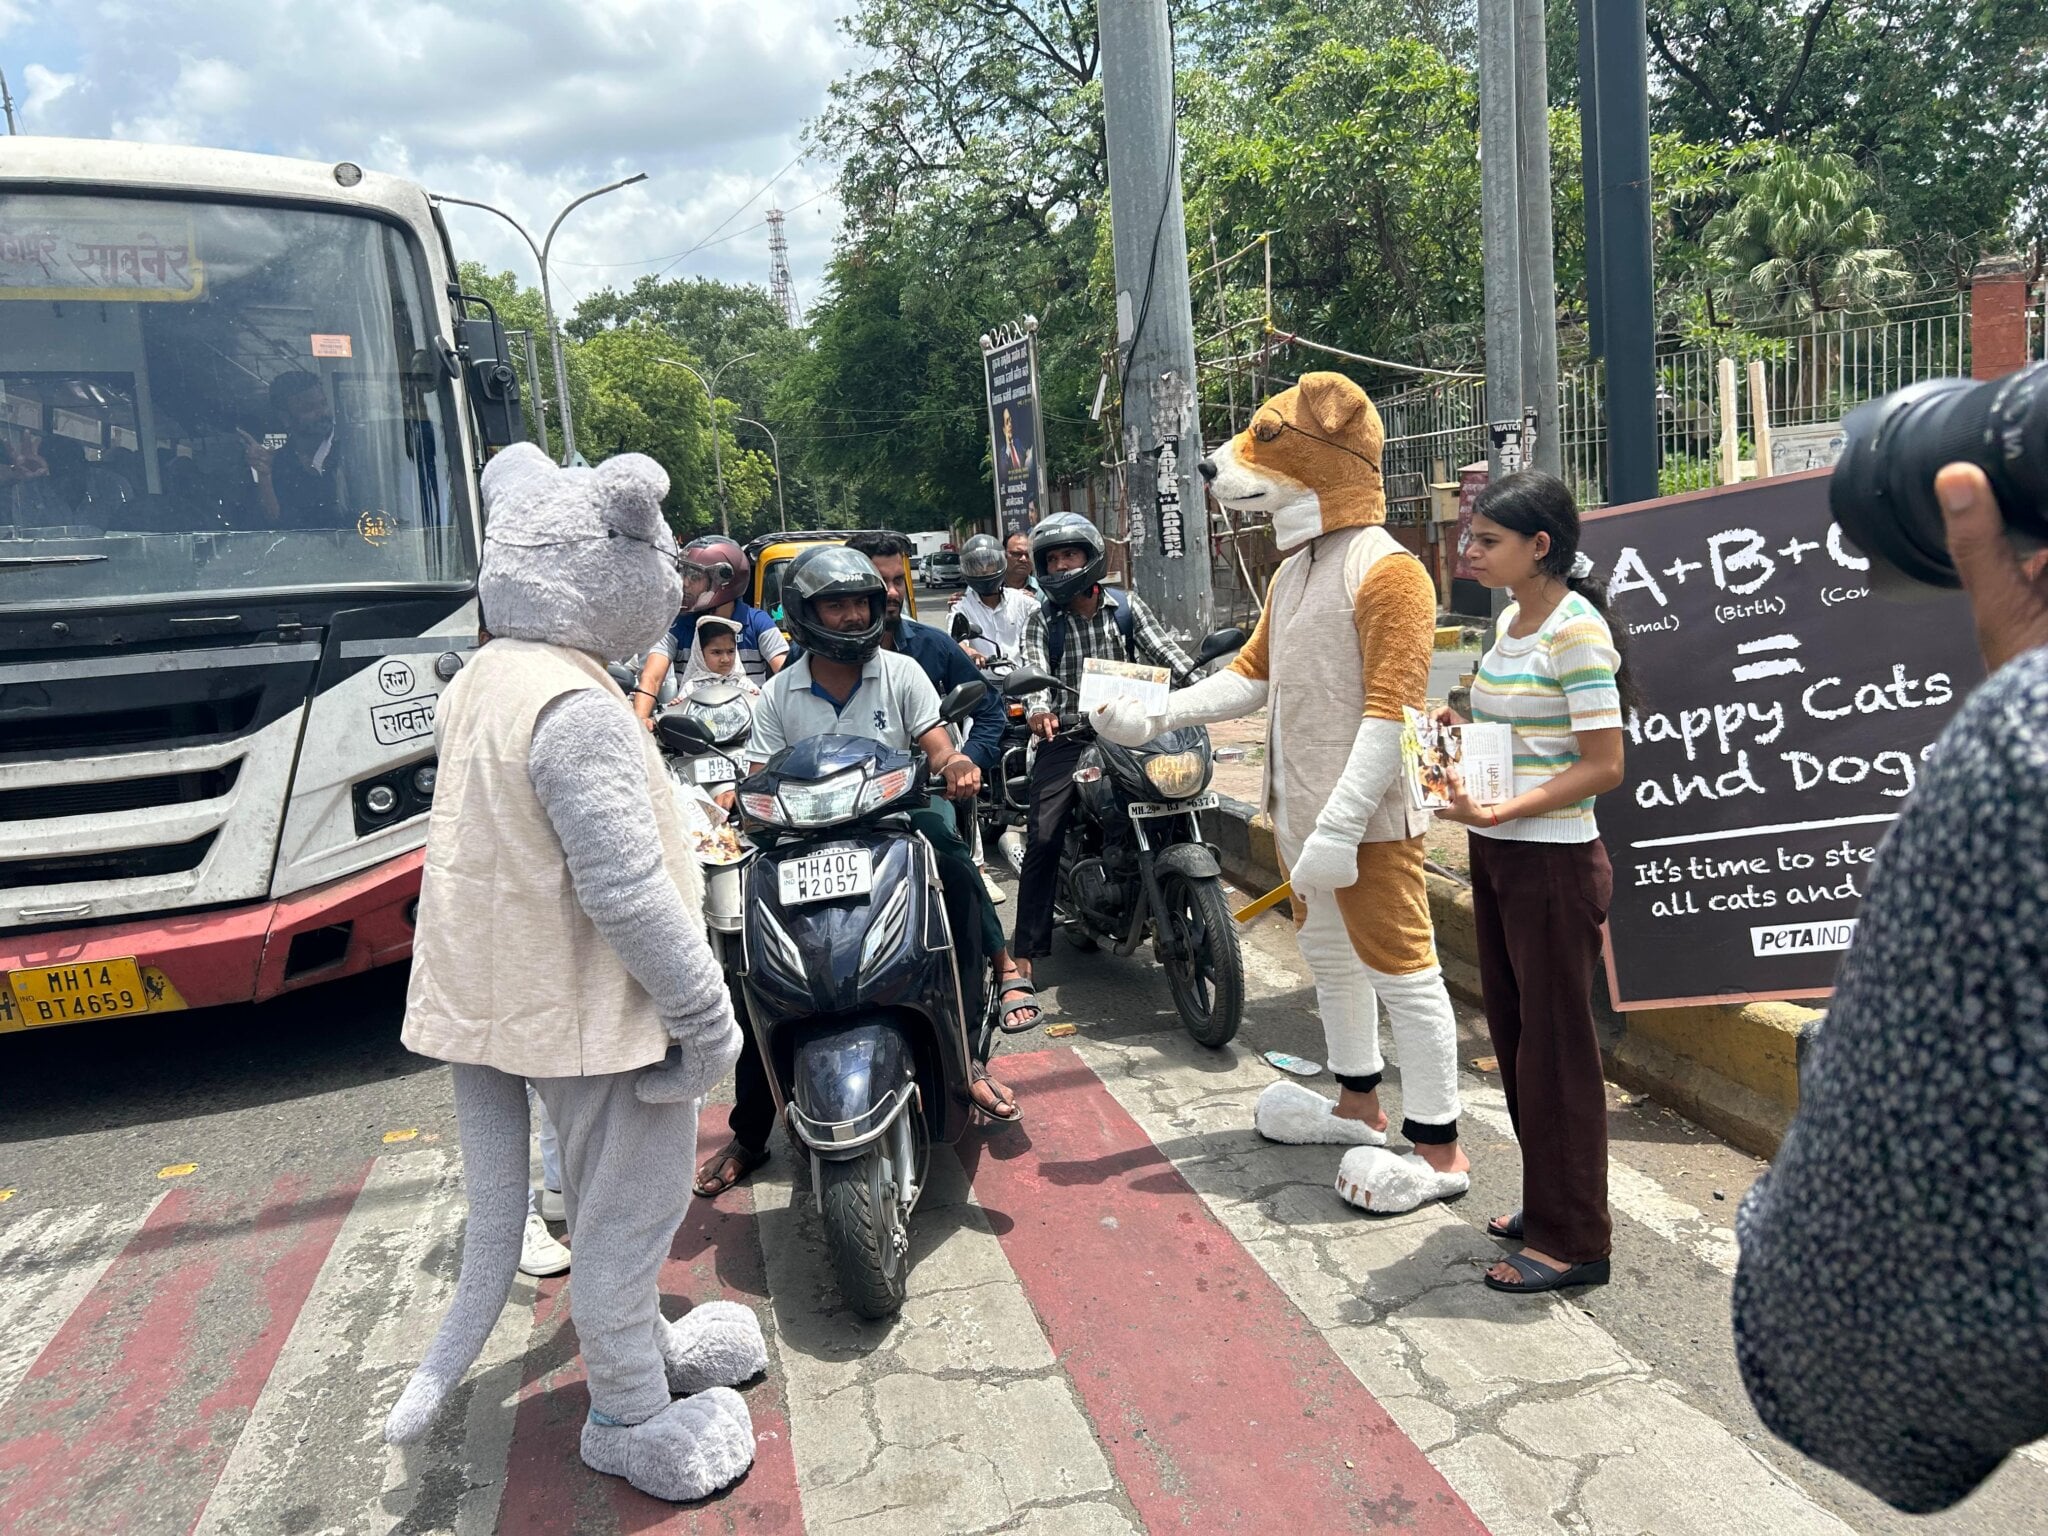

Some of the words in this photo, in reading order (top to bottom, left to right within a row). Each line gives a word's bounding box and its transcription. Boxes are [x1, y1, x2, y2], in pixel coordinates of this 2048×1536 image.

[1715, 596, 1786, 623] (Birth)
[1628, 616, 1680, 635] imal)
[1801, 663, 1953, 720] Cats
[1635, 750, 1766, 809] and
[797, 854, 858, 879] MH40C
[1634, 857, 1682, 887] It's
[1690, 856, 1770, 881] time
[1776, 847, 1815, 871] to
[1825, 840, 1876, 868] ste
[1651, 890, 1700, 917] all
[1708, 884, 1777, 912] cats
[1786, 874, 1863, 905] and
[1816, 925, 1852, 946] IND
[47, 966, 112, 993] MH14
[37, 990, 134, 1020] BT4659
